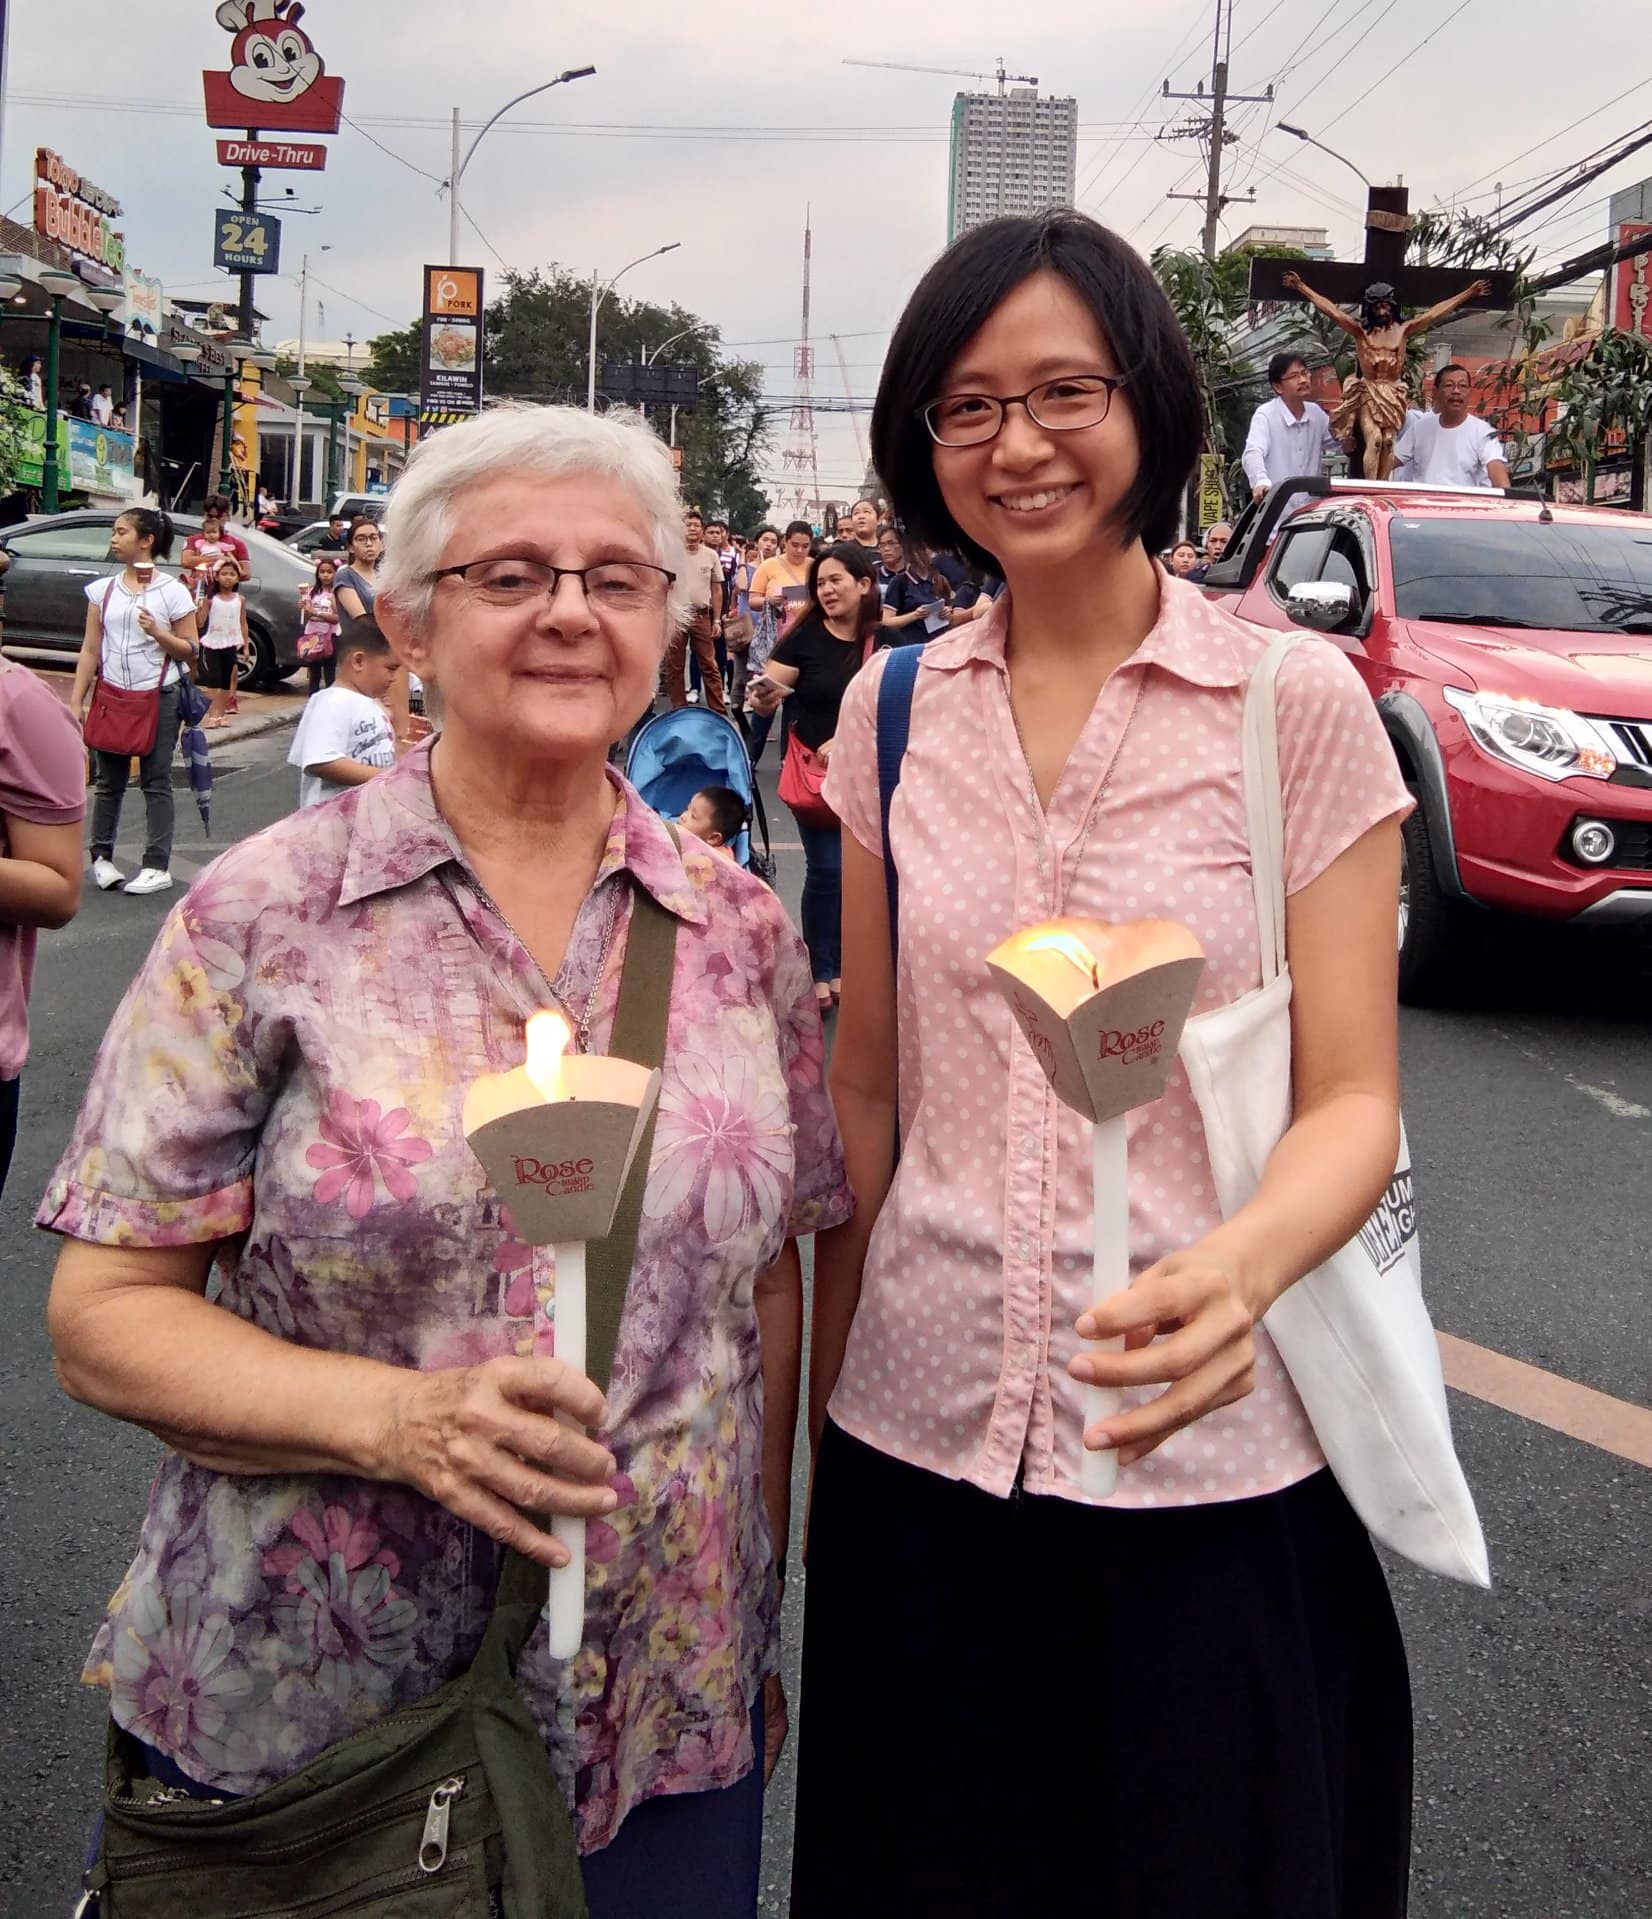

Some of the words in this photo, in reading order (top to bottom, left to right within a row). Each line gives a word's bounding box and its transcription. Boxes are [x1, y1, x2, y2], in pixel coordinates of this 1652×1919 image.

[226, 143, 314, 164] Drive-Thru
[230, 215, 260, 226] OPEN
[220, 223, 269, 256] 24
[225, 253, 264, 265] HOURS
[1203, 499, 1219, 525] VAPE
[1097, 1020, 1166, 1060] Rose
[510, 1154, 594, 1185] Rose
